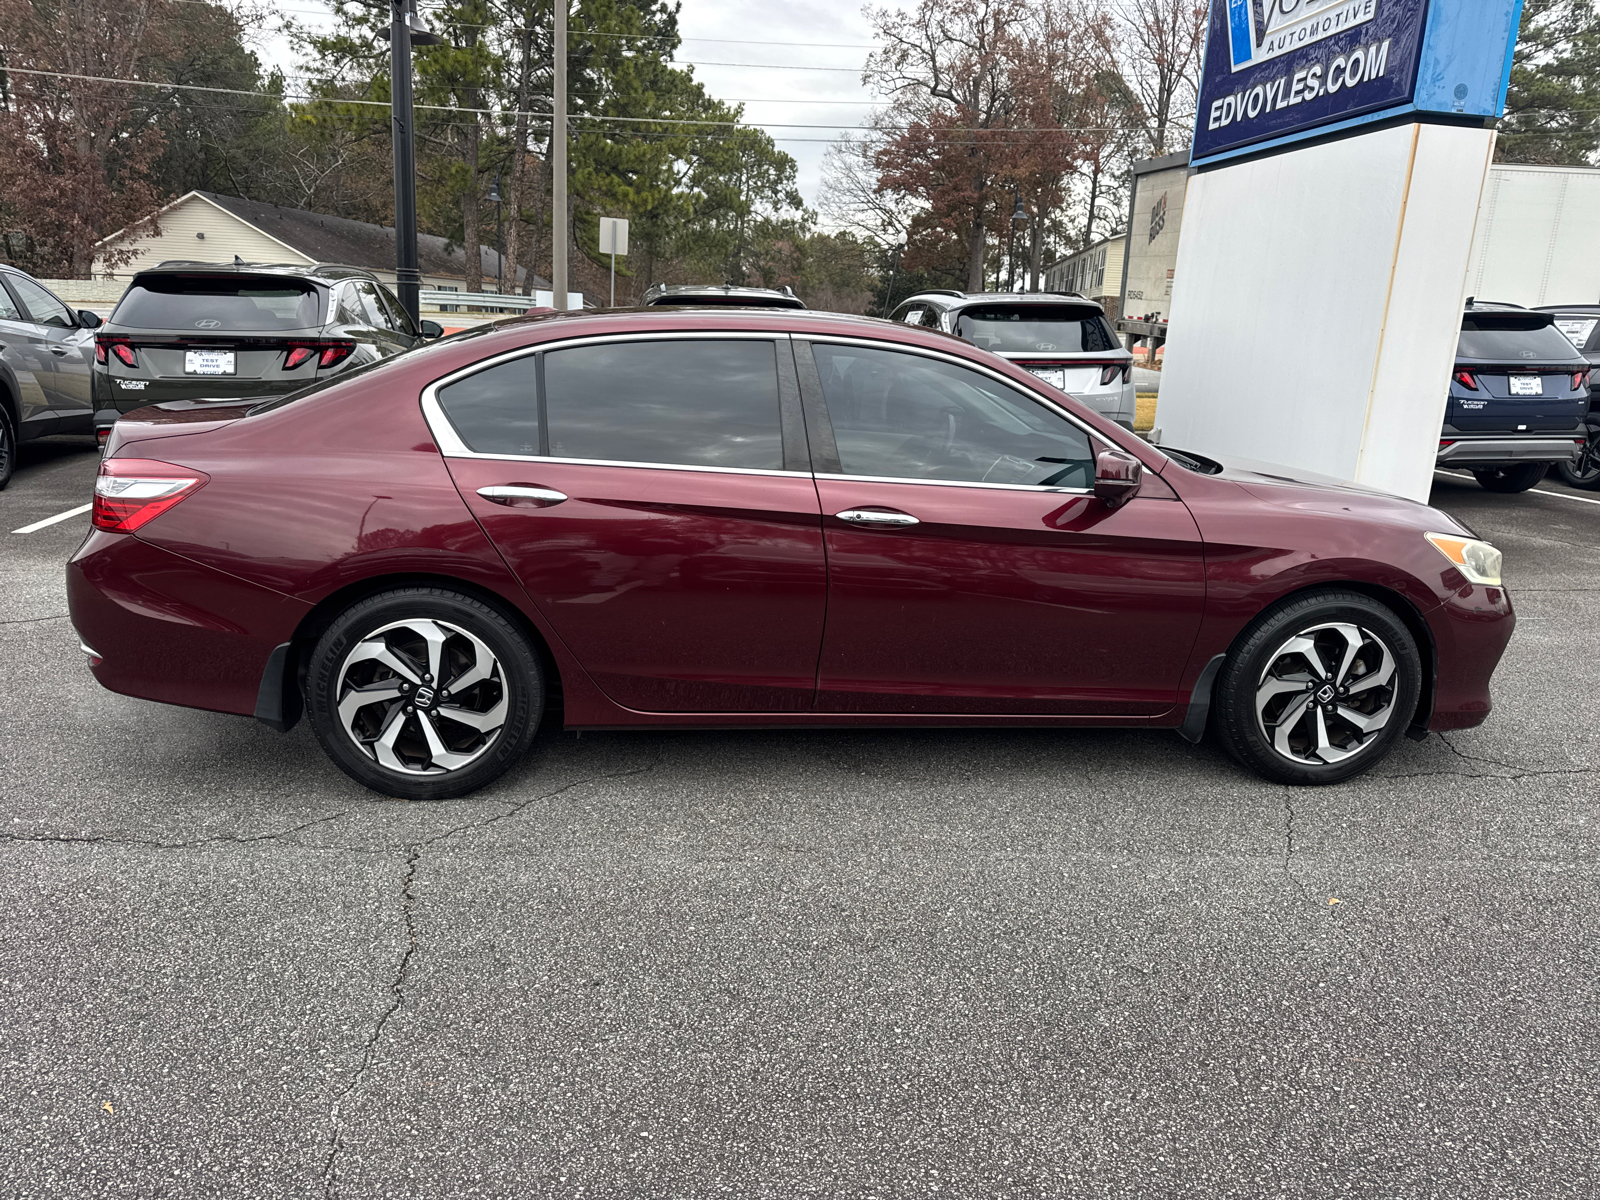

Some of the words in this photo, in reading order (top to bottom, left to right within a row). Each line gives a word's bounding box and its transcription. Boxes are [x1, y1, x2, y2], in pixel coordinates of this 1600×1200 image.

[1266, 1, 1372, 55] AUTOMOTIVE
[1207, 39, 1391, 131] EDVOYLES.COM
[317, 636, 345, 714] MICHELIN
